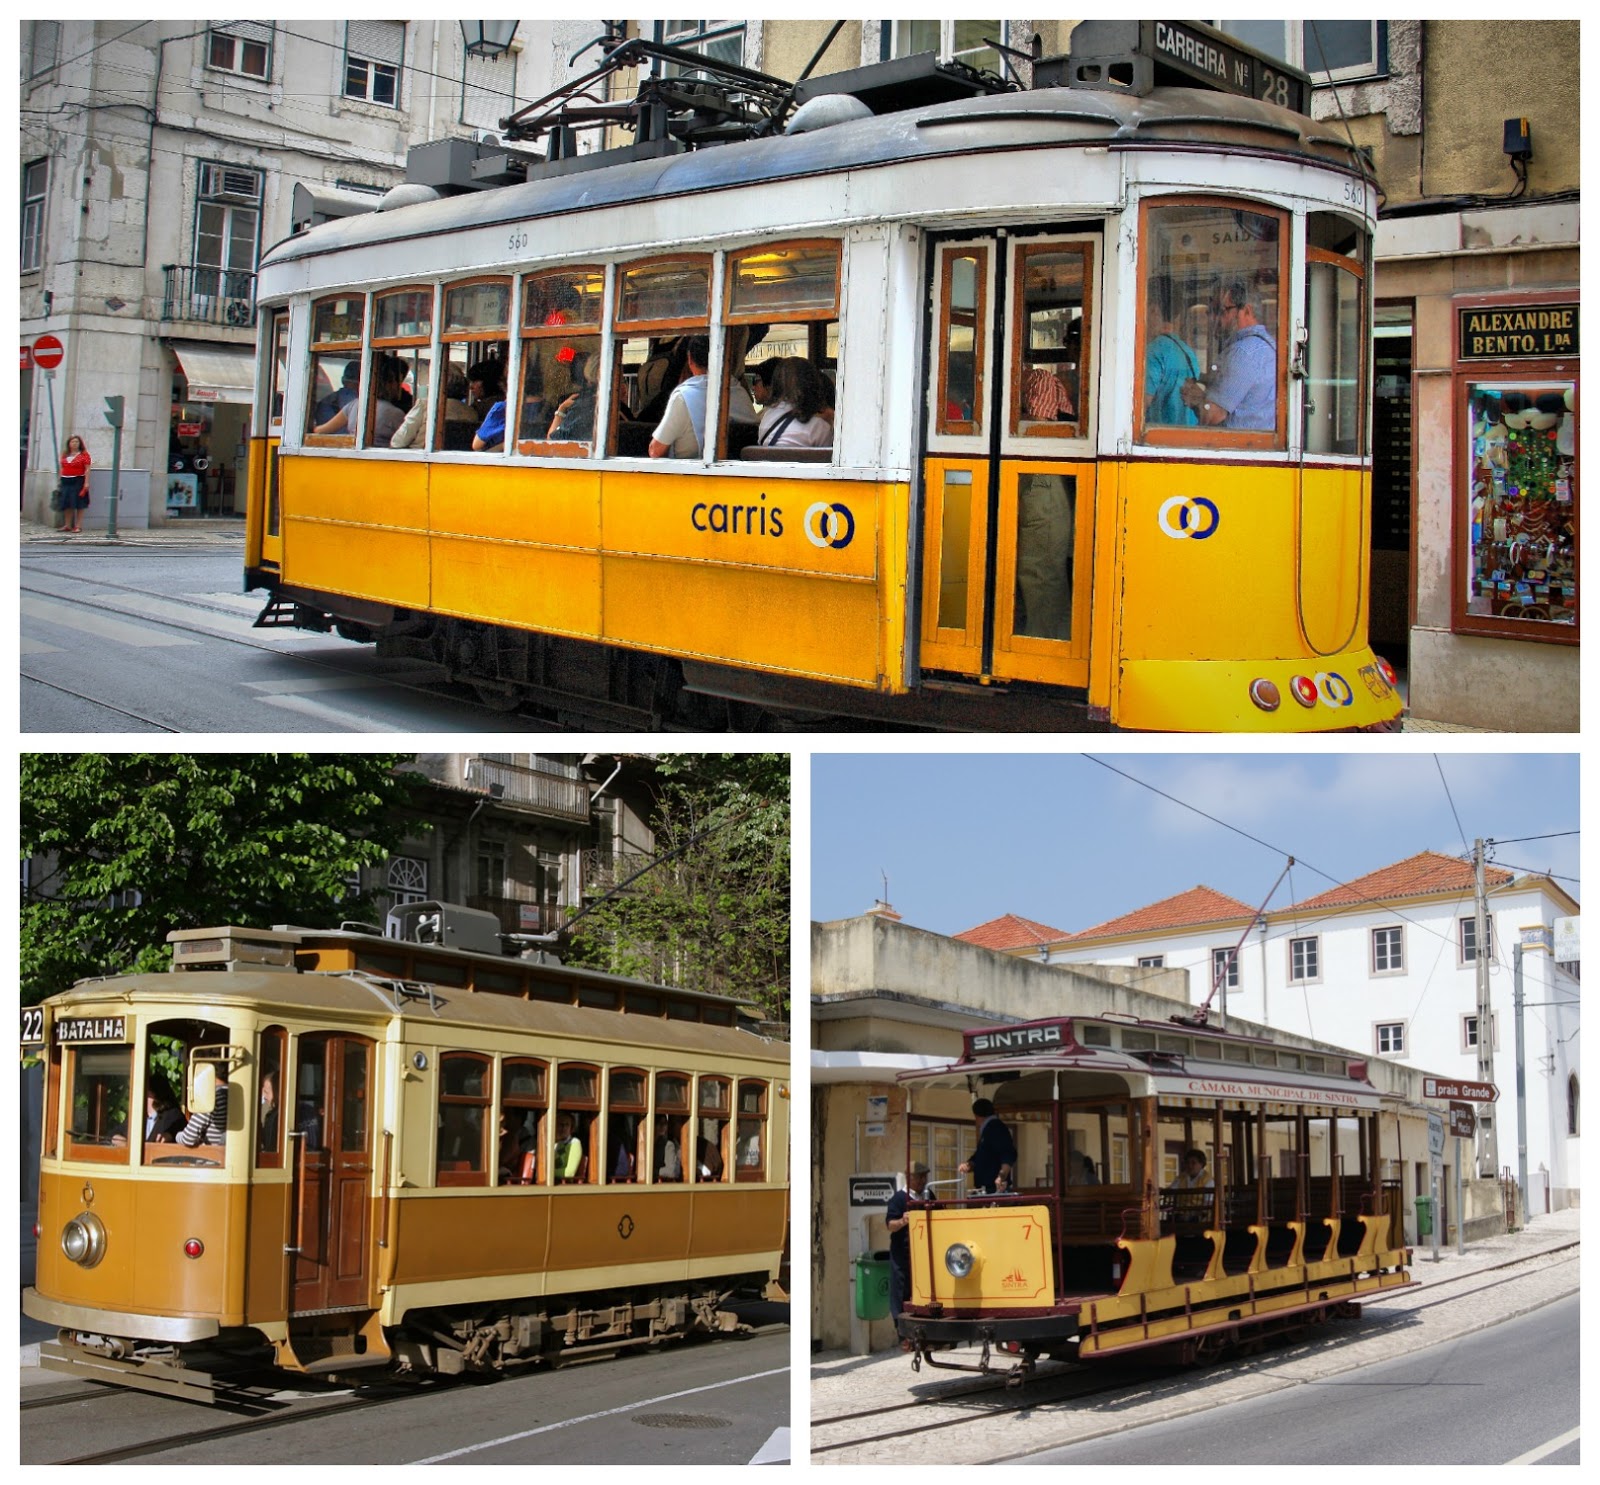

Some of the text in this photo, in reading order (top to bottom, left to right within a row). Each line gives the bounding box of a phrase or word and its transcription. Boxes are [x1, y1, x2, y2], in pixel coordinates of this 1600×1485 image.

[1156, 22, 1227, 79] CARREIRA
[1262, 69, 1288, 108] 28
[1343, 182, 1363, 205] 560
[508, 233, 528, 250] 560
[1469, 311, 1573, 332] ALEXANDRE
[691, 492, 784, 537] carris
[22, 1010, 43, 1040] 22
[59, 1019, 124, 1039] BATALHA
[973, 1026, 1061, 1050] SINTRA
[1247, 1085, 1306, 1100] MUNICIPAL
[1308, 1091, 1324, 1102] DE
[1325, 1093, 1359, 1105] SINTRA
[1438, 1084, 1489, 1098] praia Grande
[1022, 1225, 1031, 1240] 7
